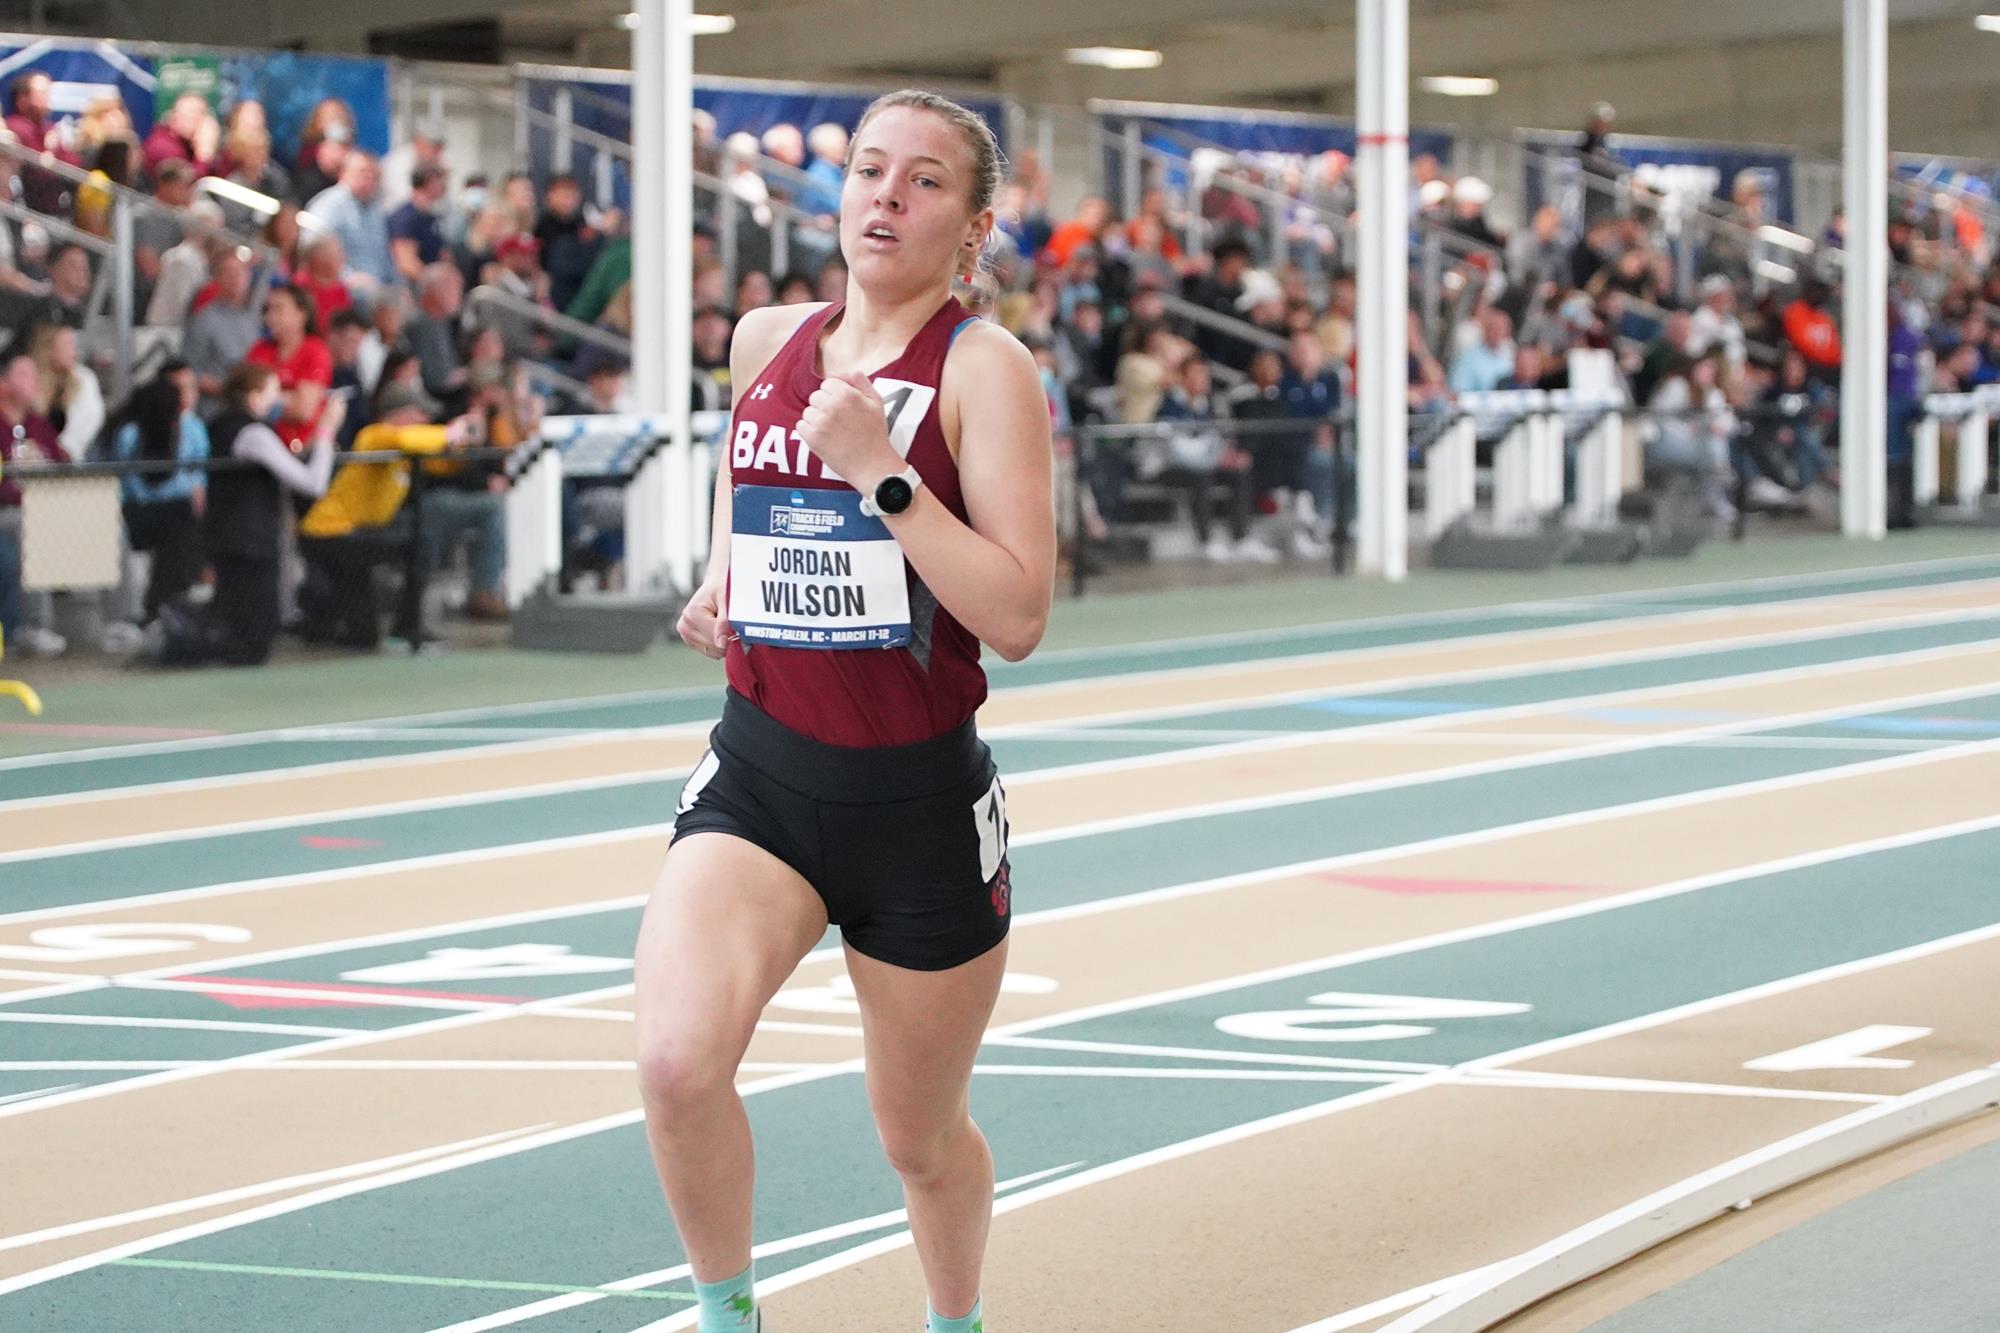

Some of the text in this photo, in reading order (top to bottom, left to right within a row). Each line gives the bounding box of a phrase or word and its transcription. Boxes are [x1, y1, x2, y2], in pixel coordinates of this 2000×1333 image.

[732, 420, 847, 482] BAT
[791, 512, 814, 525] TRACK
[821, 515, 844, 527] FIELD
[768, 546, 852, 577] JORDAN
[761, 580, 866, 617] WILSON
[811, 631, 825, 643] NC
[831, 630, 866, 642] MARCH
[868, 629, 890, 640] 11-12
